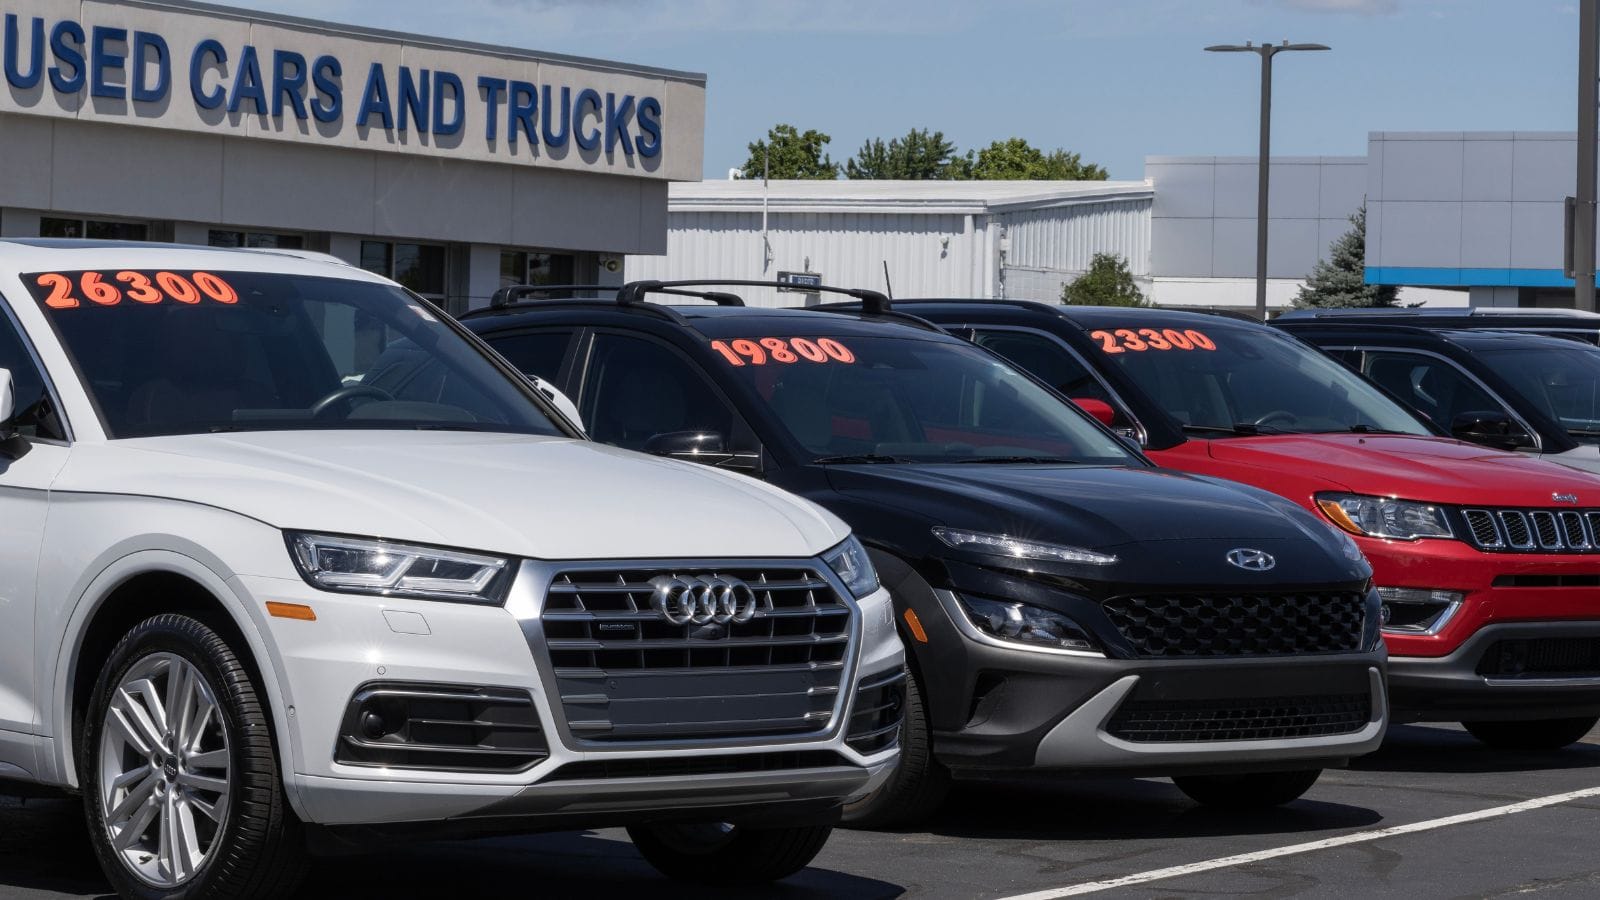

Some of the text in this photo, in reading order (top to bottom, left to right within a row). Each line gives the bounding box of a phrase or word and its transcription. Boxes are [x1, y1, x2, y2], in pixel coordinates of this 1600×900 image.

[4, 13, 661, 158] USED CARS AND TRUCKS
[37, 270, 238, 309] 26300
[711, 337, 855, 367] 19800
[1091, 328, 1217, 353] 23300
